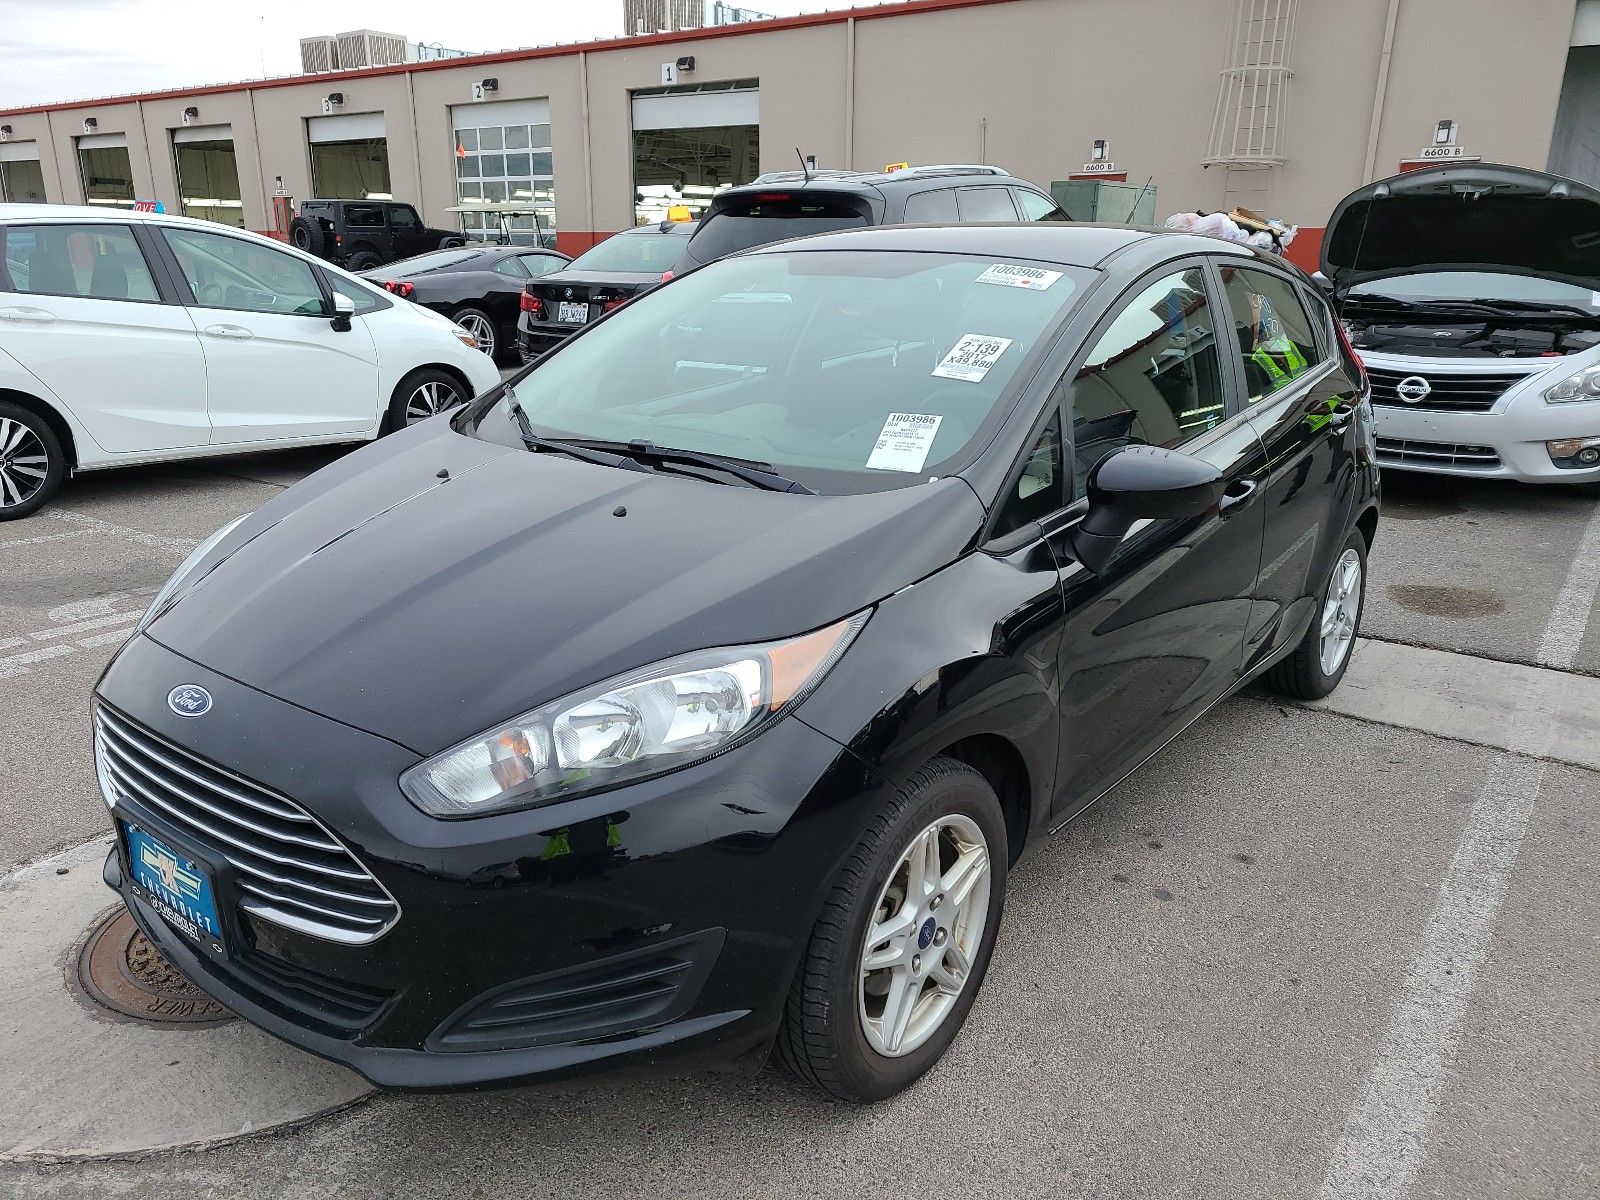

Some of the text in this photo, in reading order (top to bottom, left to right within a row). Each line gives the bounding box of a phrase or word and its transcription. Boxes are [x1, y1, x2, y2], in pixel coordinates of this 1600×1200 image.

[666, 66, 673, 82] 1
[475, 85, 482, 99] 2
[324, 100, 330, 112] 3
[1424, 147, 1461, 157] 6600 B
[1085, 163, 1105, 171] 6600
[991, 264, 1048, 280] 1003986
[959, 350, 988, 361] 2017
[890, 414, 937, 425] 1003986
[174, 689, 203, 711] Ford
[140, 871, 212, 933] CHEVROLET
